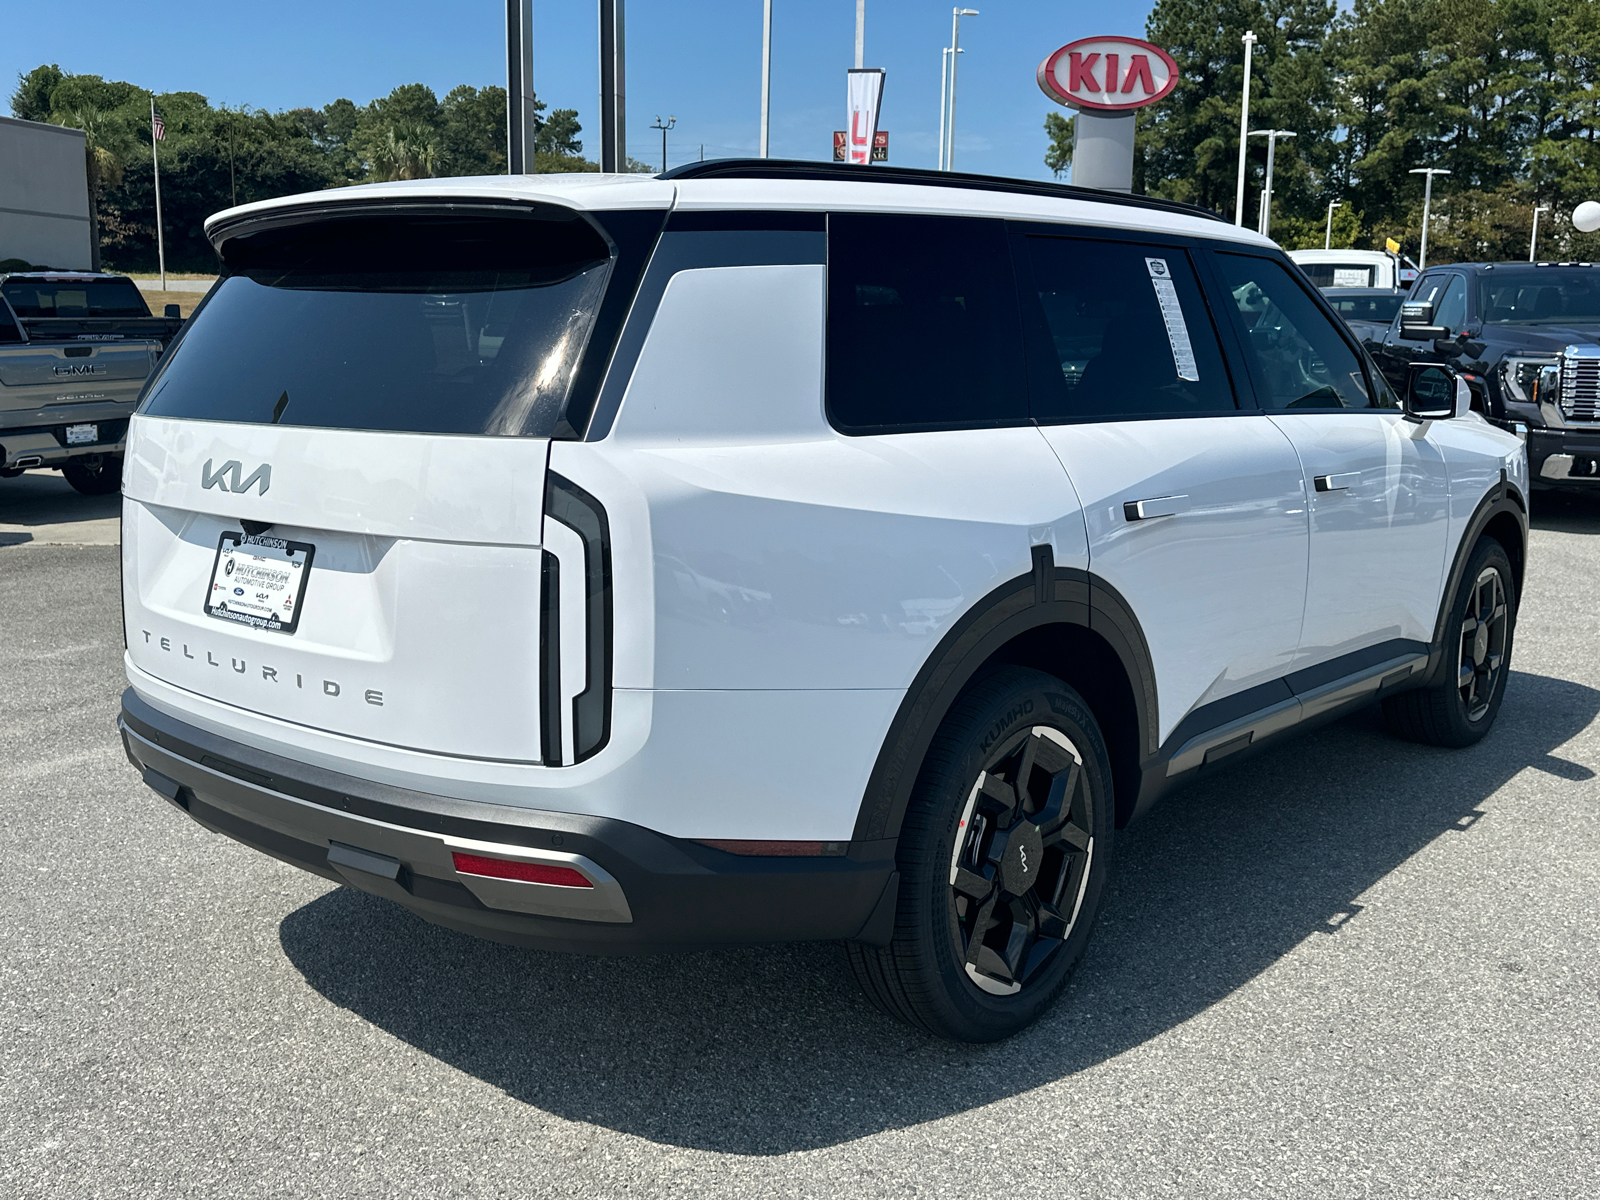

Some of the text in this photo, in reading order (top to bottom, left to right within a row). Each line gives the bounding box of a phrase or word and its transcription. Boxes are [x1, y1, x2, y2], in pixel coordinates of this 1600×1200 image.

[1068, 52, 1156, 94] KIA
[53, 363, 107, 377] GMC
[247, 535, 288, 550] HUTCHINSON
[234, 576, 265, 589] AUTOMOTIVE
[265, 581, 285, 592] GROUP
[142, 629, 384, 707] TELLURIDE
[979, 698, 1035, 755] KUMHO
